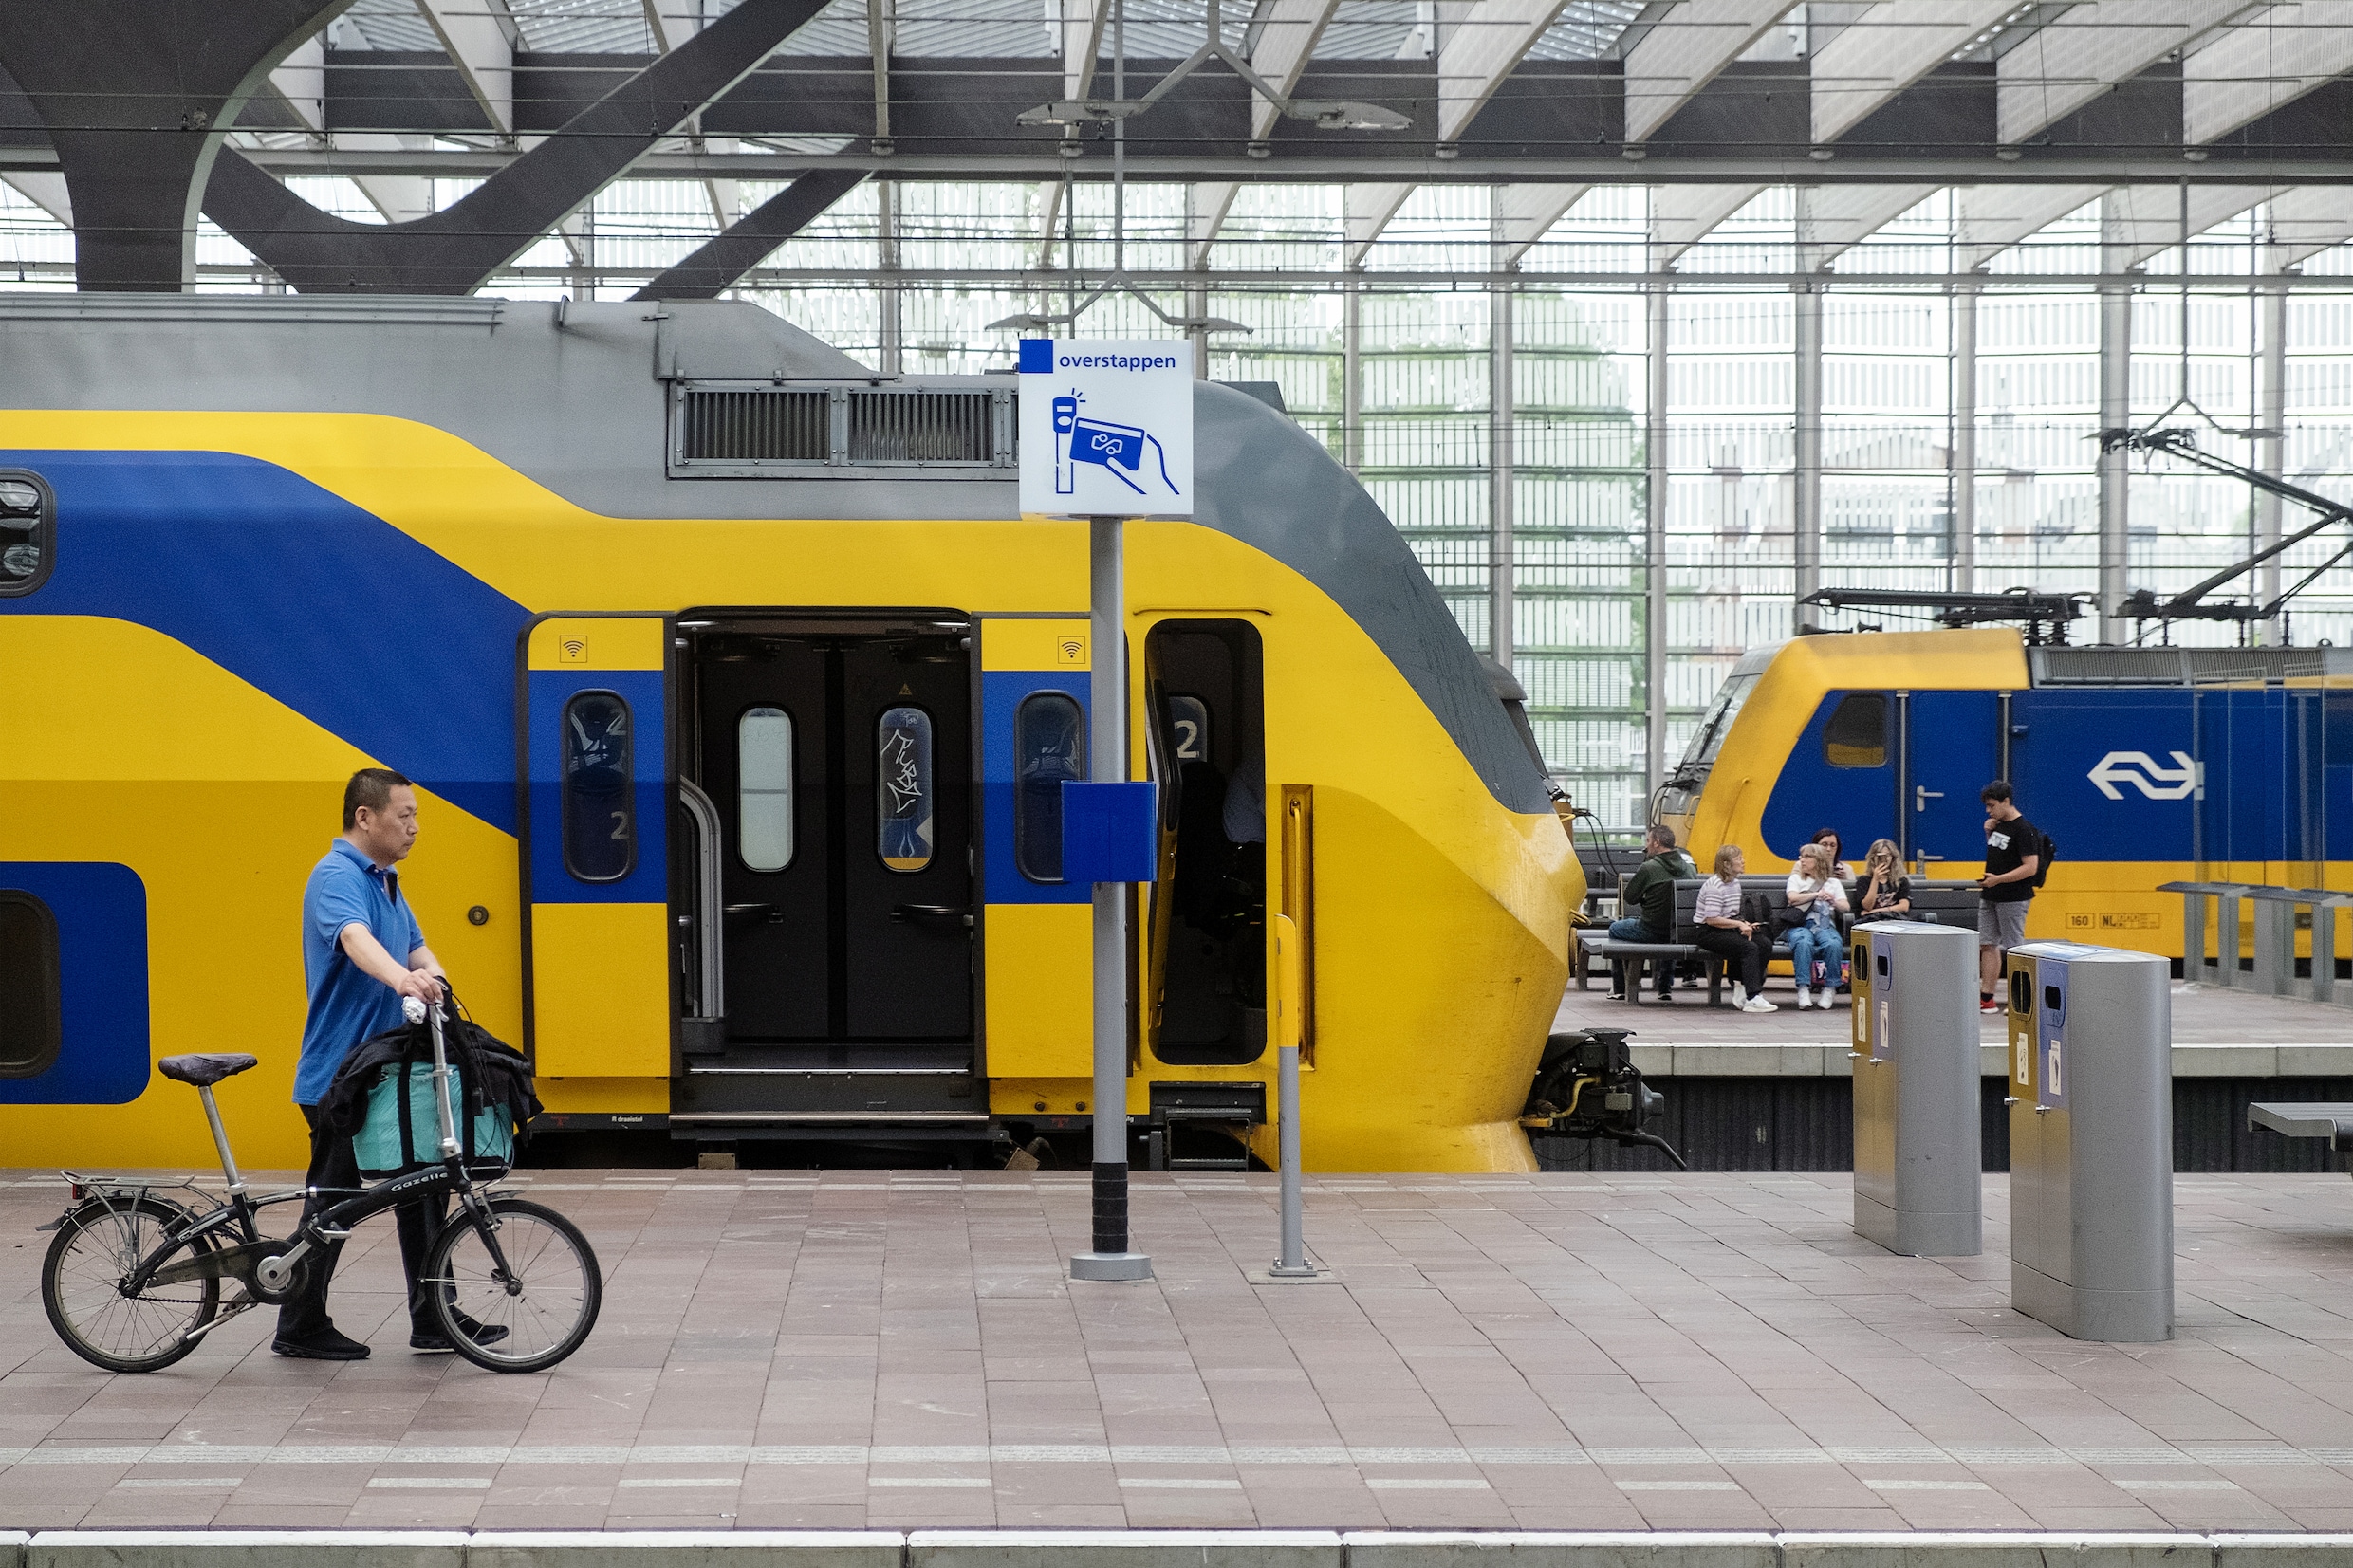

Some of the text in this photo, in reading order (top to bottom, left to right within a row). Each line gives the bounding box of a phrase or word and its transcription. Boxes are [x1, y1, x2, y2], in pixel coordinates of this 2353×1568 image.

[1059, 354, 1176, 372] overstappen
[1174, 719, 1200, 758] 2
[610, 810, 630, 839] 2
[2071, 915, 2089, 926] 160
[391, 1172, 448, 1192] Gazelle
